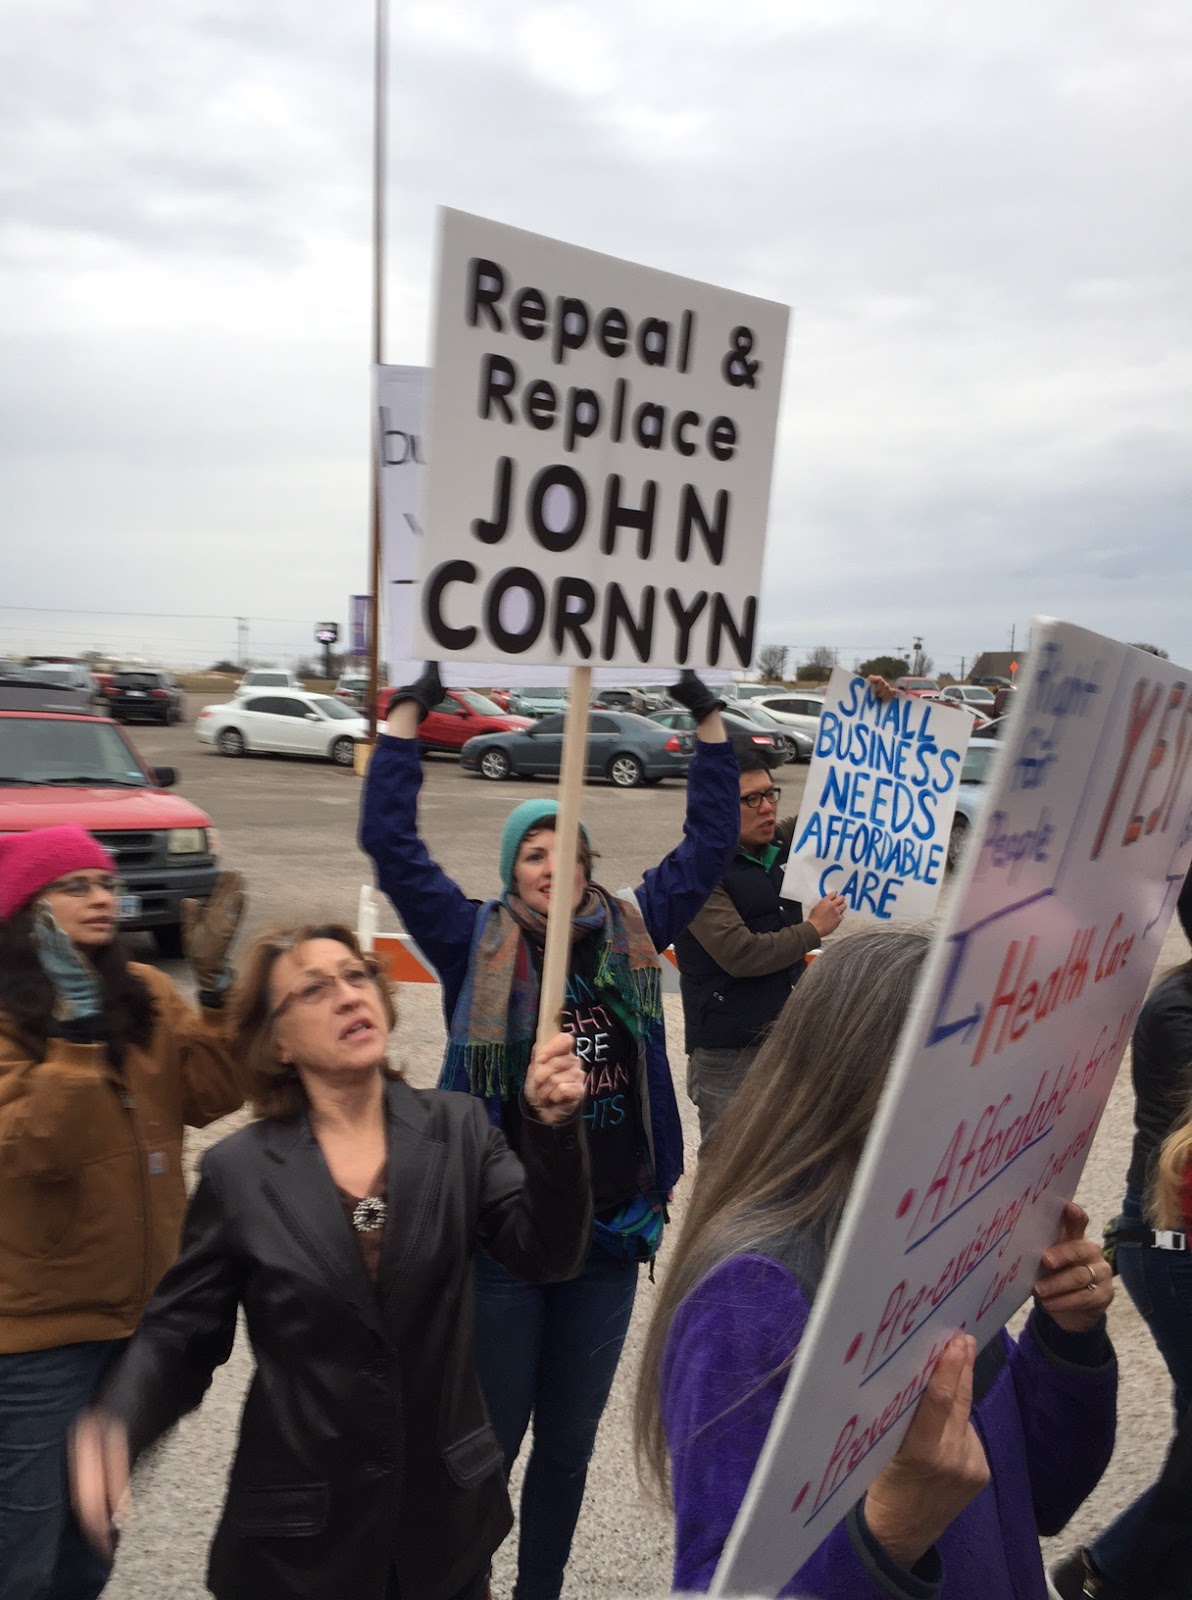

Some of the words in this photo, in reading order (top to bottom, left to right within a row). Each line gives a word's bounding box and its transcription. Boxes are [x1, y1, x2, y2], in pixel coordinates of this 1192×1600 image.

[466, 256, 695, 374] Repeal
[721, 326, 760, 389] &
[476, 352, 739, 461] Replace
[470, 455, 731, 565] JOHN
[423, 559, 757, 667] CORNYN
[815, 711, 960, 793] BUSINESS
[838, 677, 935, 742] SMALL
[794, 811, 943, 885] AFFORDABLE
[819, 765, 938, 840] NEEDS
[818, 864, 903, 919] CARE
[560, 1004, 613, 1034] GHT
[971, 925, 1097, 1067] Health
[1095, 912, 1135, 983] Care
[576, 1032, 610, 1062] RE
[904, 1051, 1079, 1242] Affordable
[1078, 1025, 1107, 1094] for
[862, 1185, 1032, 1375] Pre-existing
[811, 1321, 966, 1513] Prevent
